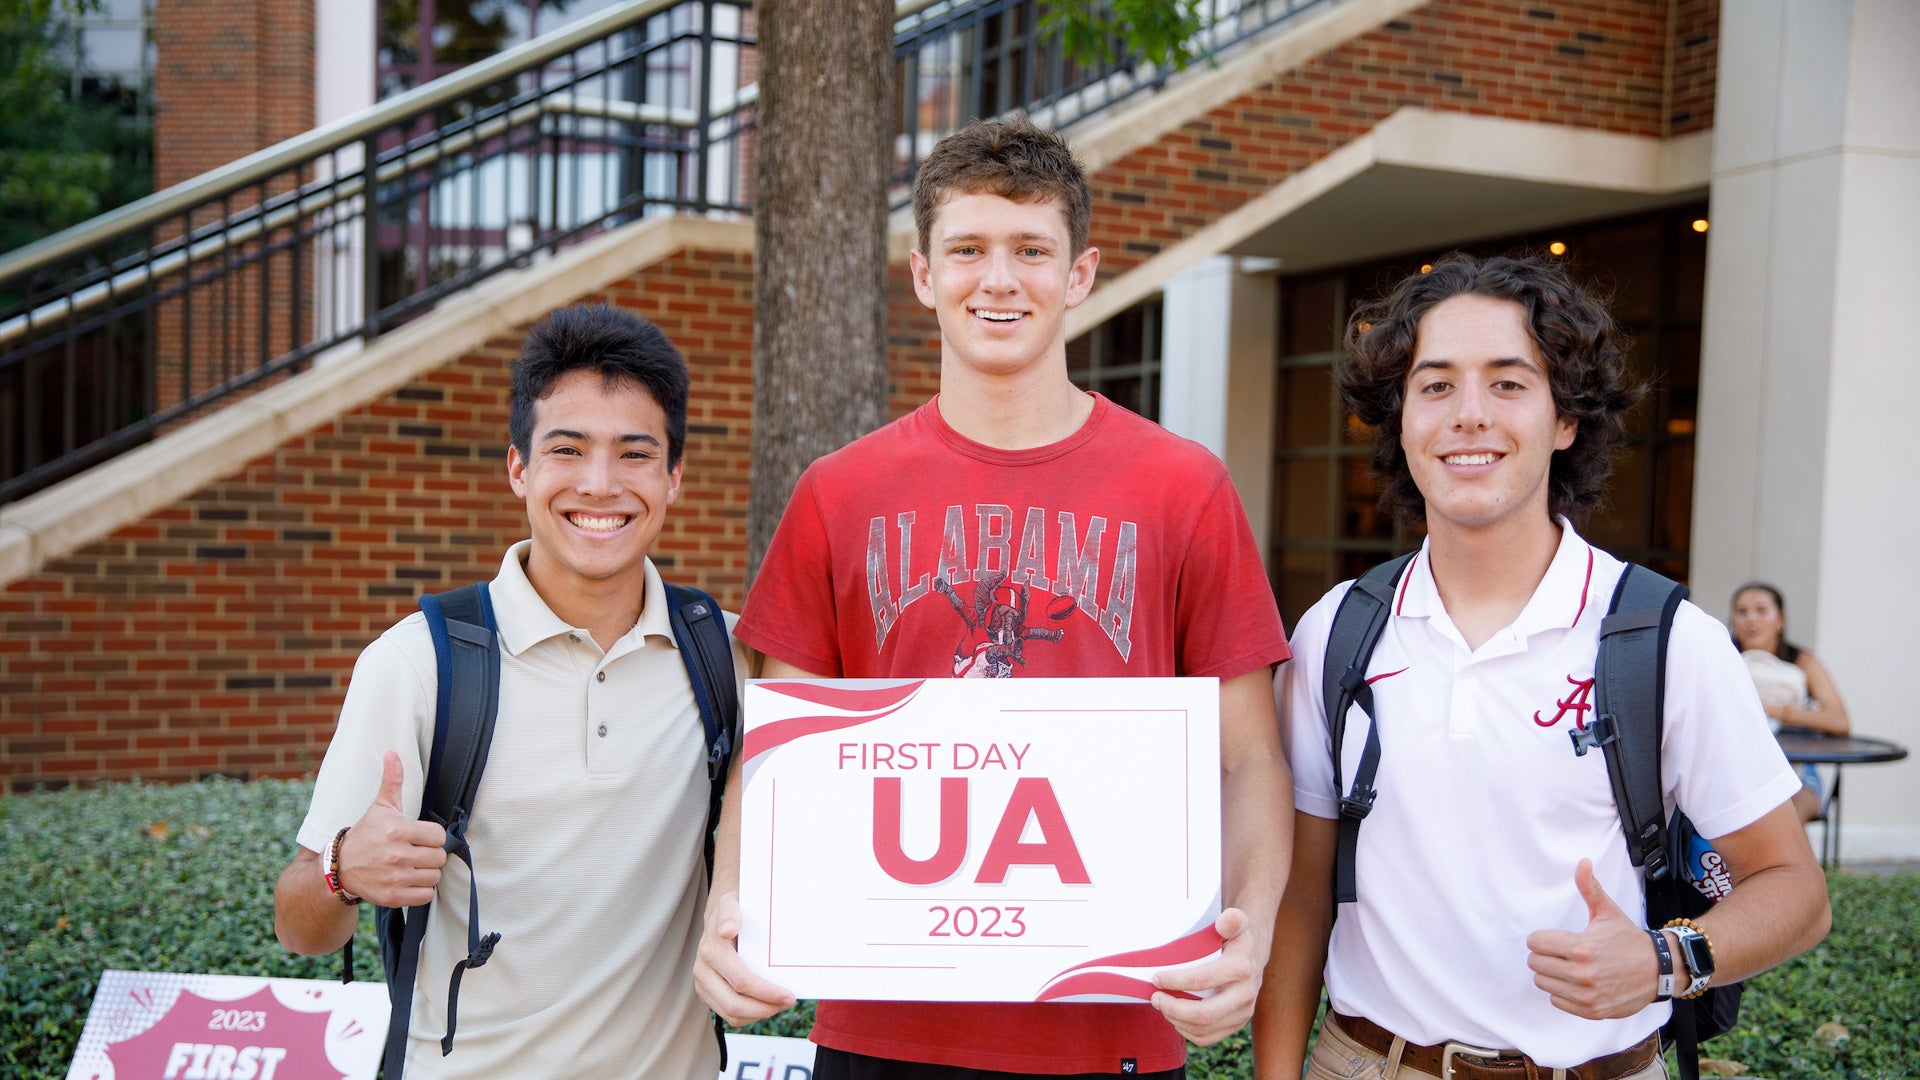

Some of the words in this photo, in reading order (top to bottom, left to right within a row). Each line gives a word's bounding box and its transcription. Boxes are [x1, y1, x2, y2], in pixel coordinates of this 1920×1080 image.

[866, 503, 1137, 664] ALABAMA
[838, 743, 941, 770] FIRST
[953, 743, 1031, 770] DAY
[872, 777, 1095, 887] UA
[928, 906, 1026, 938] 2023
[207, 1009, 267, 1032] 2023
[162, 1042, 287, 1080] FIRST
